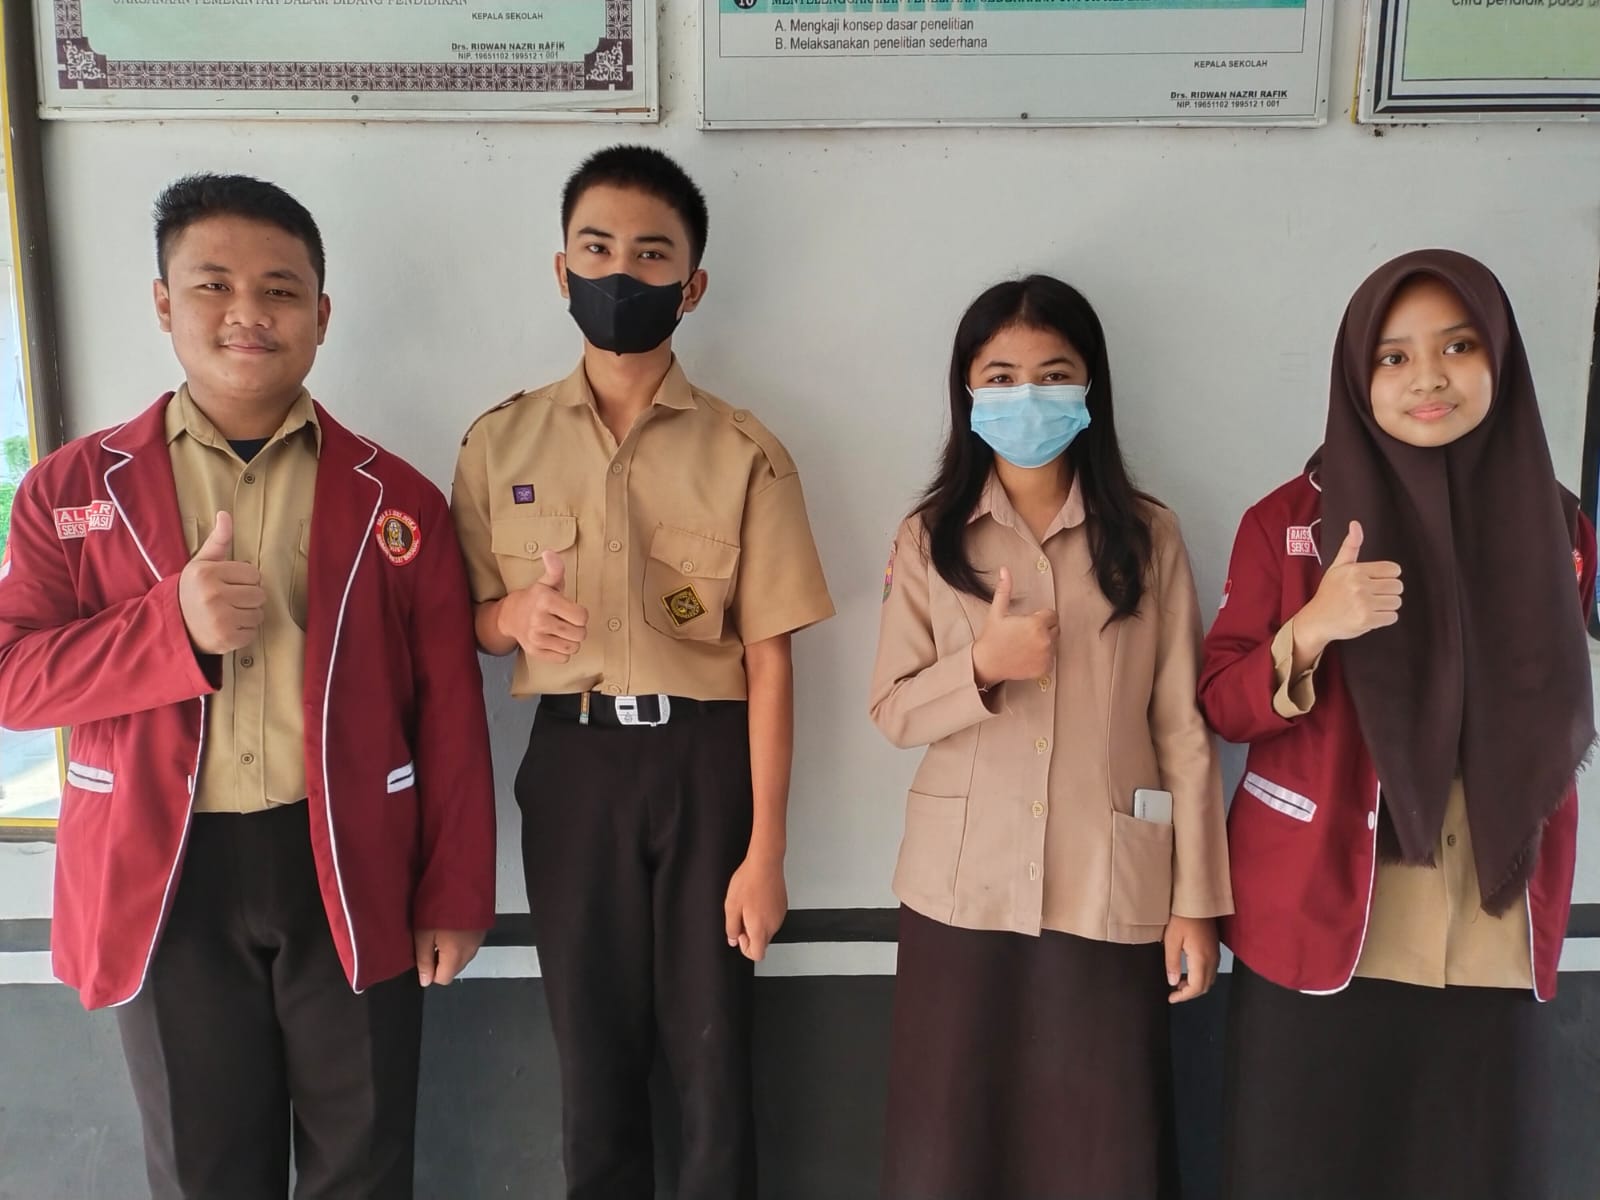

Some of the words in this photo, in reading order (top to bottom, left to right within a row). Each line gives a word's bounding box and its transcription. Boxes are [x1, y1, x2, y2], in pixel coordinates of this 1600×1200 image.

[471, 12, 503, 20] KEPALA
[505, 12, 543, 20] SEKOLAH
[775, 20, 787, 32] A.
[790, 19, 840, 34] Mengkaji
[843, 18, 883, 32] konsep
[886, 18, 918, 31] dasar
[920, 18, 974, 32] penelitian
[451, 42, 469, 51] Drs.
[471, 42, 507, 50] RIDWAN
[509, 42, 536, 50] NAZRI
[538, 41, 566, 50] RAFIK
[775, 37, 787, 50] B.
[790, 37, 870, 50] Melaksanakan
[873, 37, 926, 51] penelitian
[929, 36, 988, 49] sederhana
[1194, 60, 1226, 69] KEPALA
[1229, 60, 1268, 68] SEKOLAH
[1170, 91, 1188, 99] Drs.
[1190, 91, 1227, 99] RIDWAN
[1229, 90, 1257, 98] NAZRI
[1260, 90, 1288, 98] RAFIK
